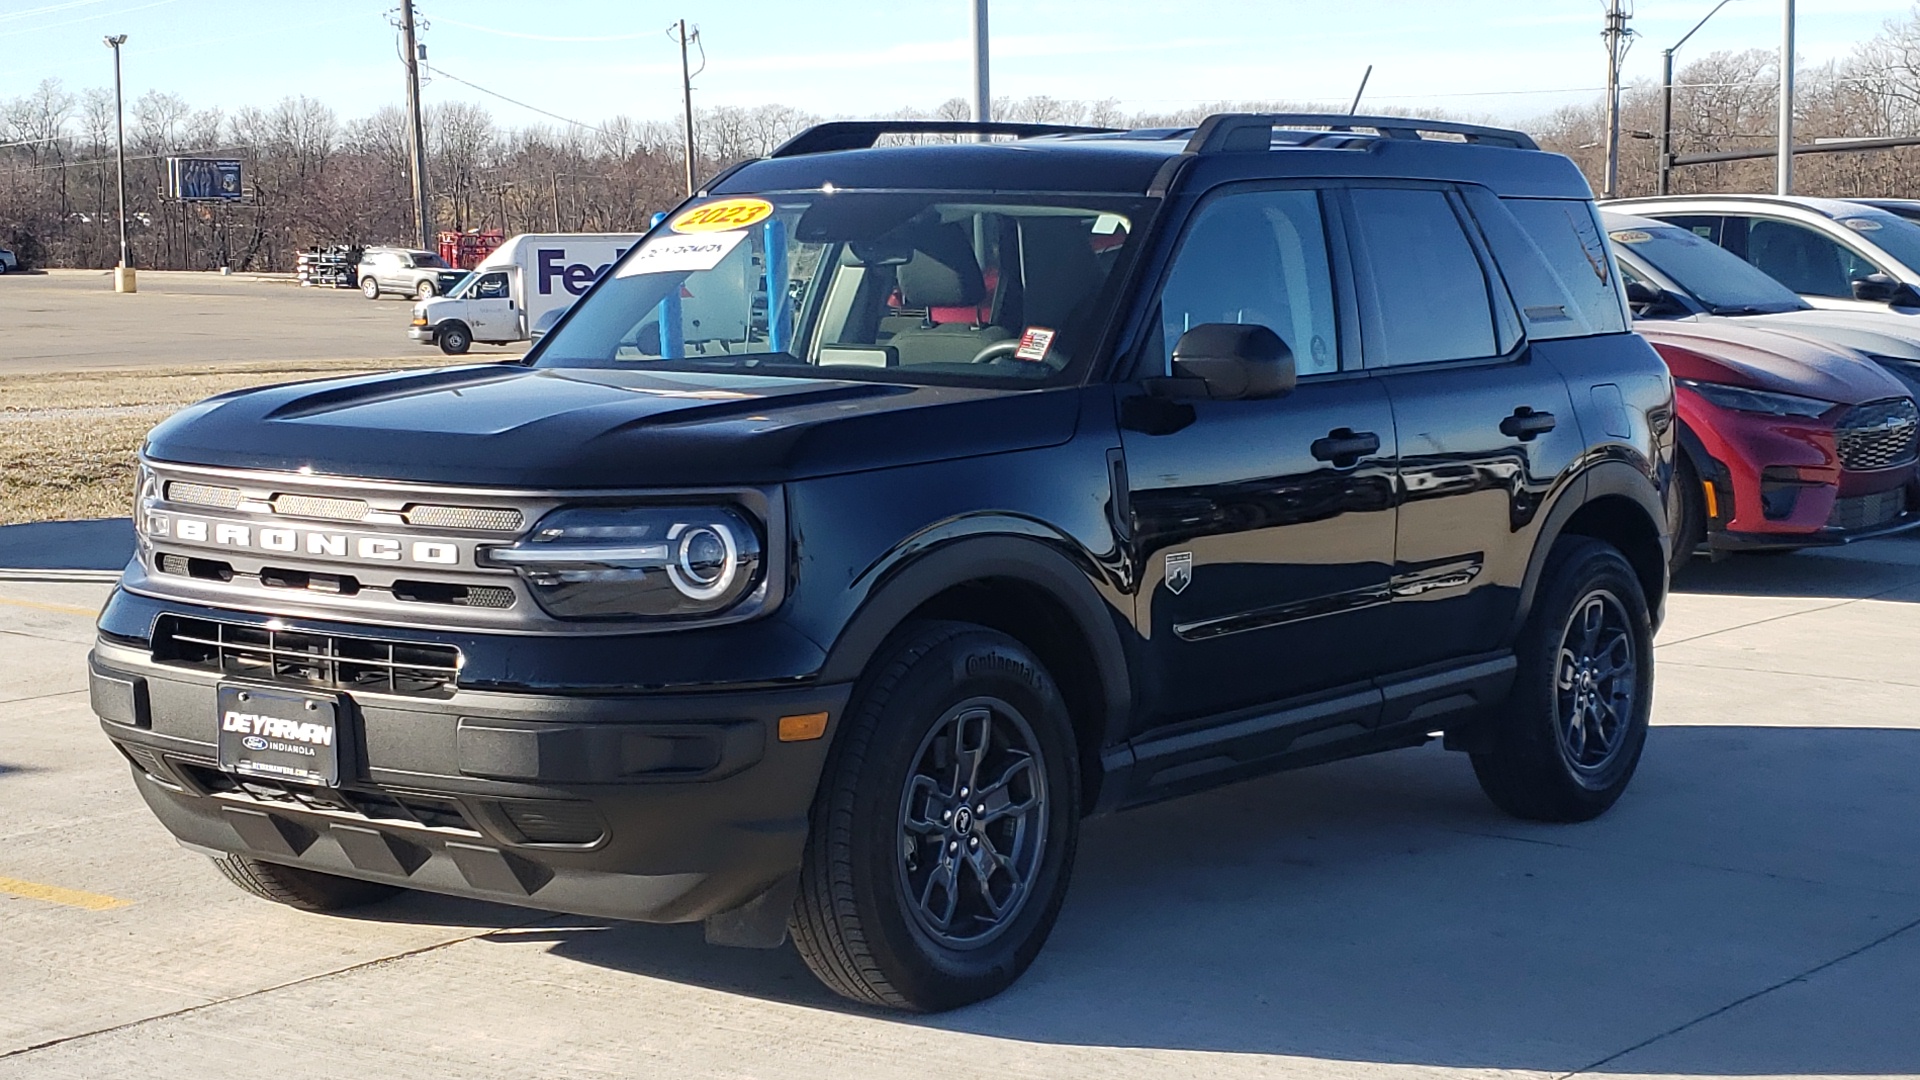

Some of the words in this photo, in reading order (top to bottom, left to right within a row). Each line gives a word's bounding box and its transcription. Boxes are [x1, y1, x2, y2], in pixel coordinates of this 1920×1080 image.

[679, 206, 766, 226] 2023
[176, 519, 459, 565] BRONCO
[965, 651, 1034, 686] Continental
[222, 711, 333, 746] DEYARMAN
[269, 741, 315, 756] INDIANOLA
